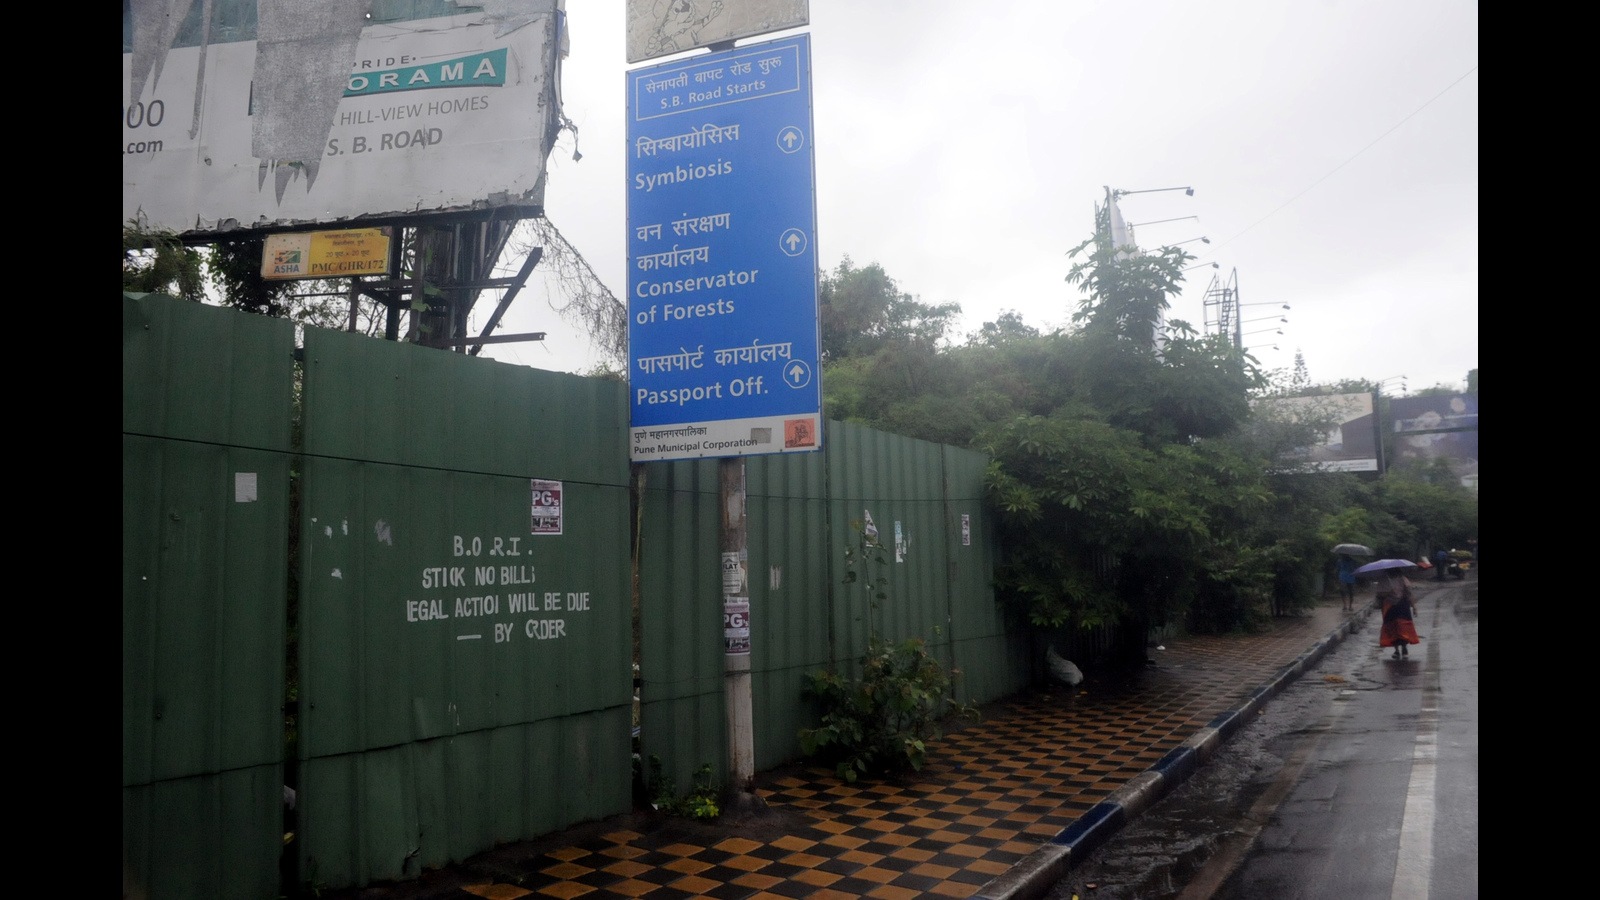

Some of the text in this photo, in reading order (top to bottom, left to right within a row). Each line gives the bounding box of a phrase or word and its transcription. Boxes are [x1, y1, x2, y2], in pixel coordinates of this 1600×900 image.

[349, 58, 496, 91] ORAMA
[646, 56, 782, 93] सेनापती बापट रोड सुरू
[661, 80, 766, 109] S.B. Road Starts
[123, 99, 165, 129] 00
[341, 95, 489, 126] HILL-VIEW HOMES
[327, 127, 443, 156] S. B. ROAD
[636, 123, 740, 158] सिम्बायोसिस
[635, 159, 732, 192] Symbiosis
[636, 213, 730, 242] वन संरक्षण
[274, 265, 299, 273] ASHA
[312, 260, 384, 272] PMC/GHR/172
[637, 245, 709, 272] कार्यालय
[637, 269, 758, 298] Conservator
[637, 299, 735, 325] of Forests
[638, 339, 792, 374] पासपोर्ट कार्यालय
[637, 376, 769, 406] Passport Off.
[634, 426, 707, 443] पुणे महानगरपालिका
[634, 437, 758, 454] Pune Municipal Corporation
[475, 566, 495, 586] NO
[509, 593, 539, 613] WILL
[544, 593, 561, 611] BE
[567, 593, 590, 612] DUE
[495, 623, 514, 643] BY
